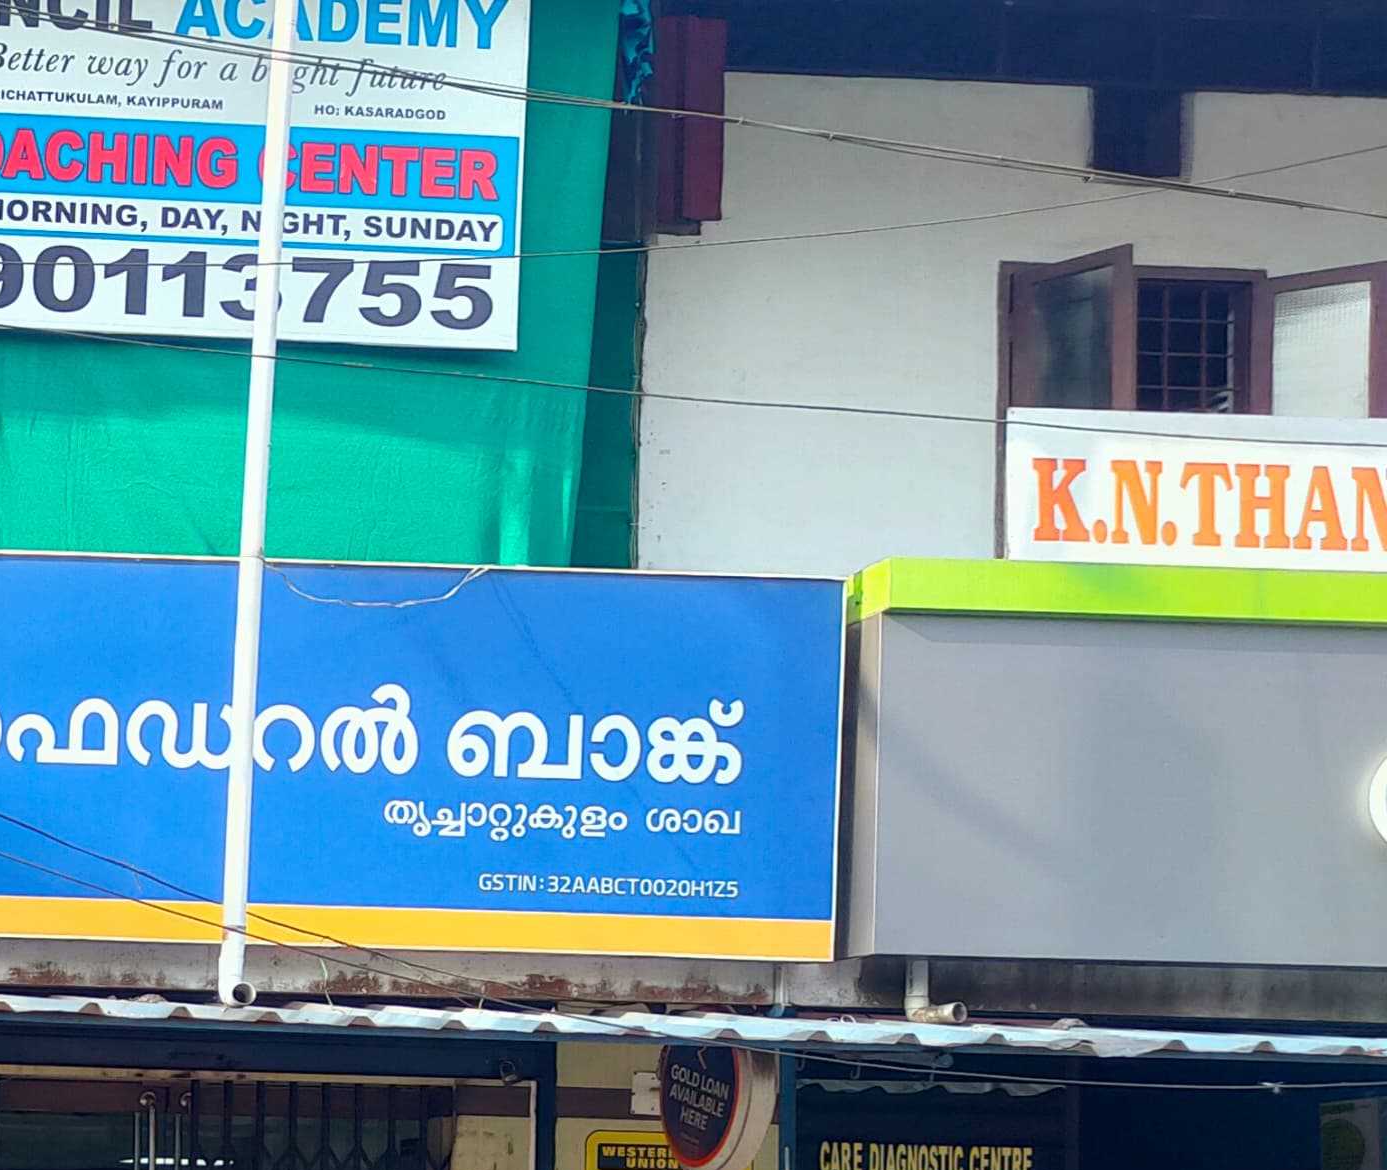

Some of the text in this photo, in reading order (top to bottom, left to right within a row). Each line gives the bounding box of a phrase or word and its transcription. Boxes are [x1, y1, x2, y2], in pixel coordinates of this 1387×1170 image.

[87, 56, 148, 87] way
[155, 50, 207, 89] for
[219, 62, 237, 82] a
[251, 54, 339, 94] bght
[346, 58, 447, 97] future
[127, 95, 224, 111] KAYIPPURAM
[345, 106, 447, 121] KASARADGOD
[161, 206, 229, 234] DAY,
[241, 208, 351, 241] NGHT,
[363, 214, 499, 243] SUNDAY
[447, 698, 745, 785] ബാങ്ക്
[645, 807, 742, 835] ശാഖ
[670, 1063, 730, 1100] GOLD LOAN
[669, 1083, 725, 1118] AVAILABLE
[680, 1108, 708, 1131] HERE
[626, 1158, 678, 1169] UNION
